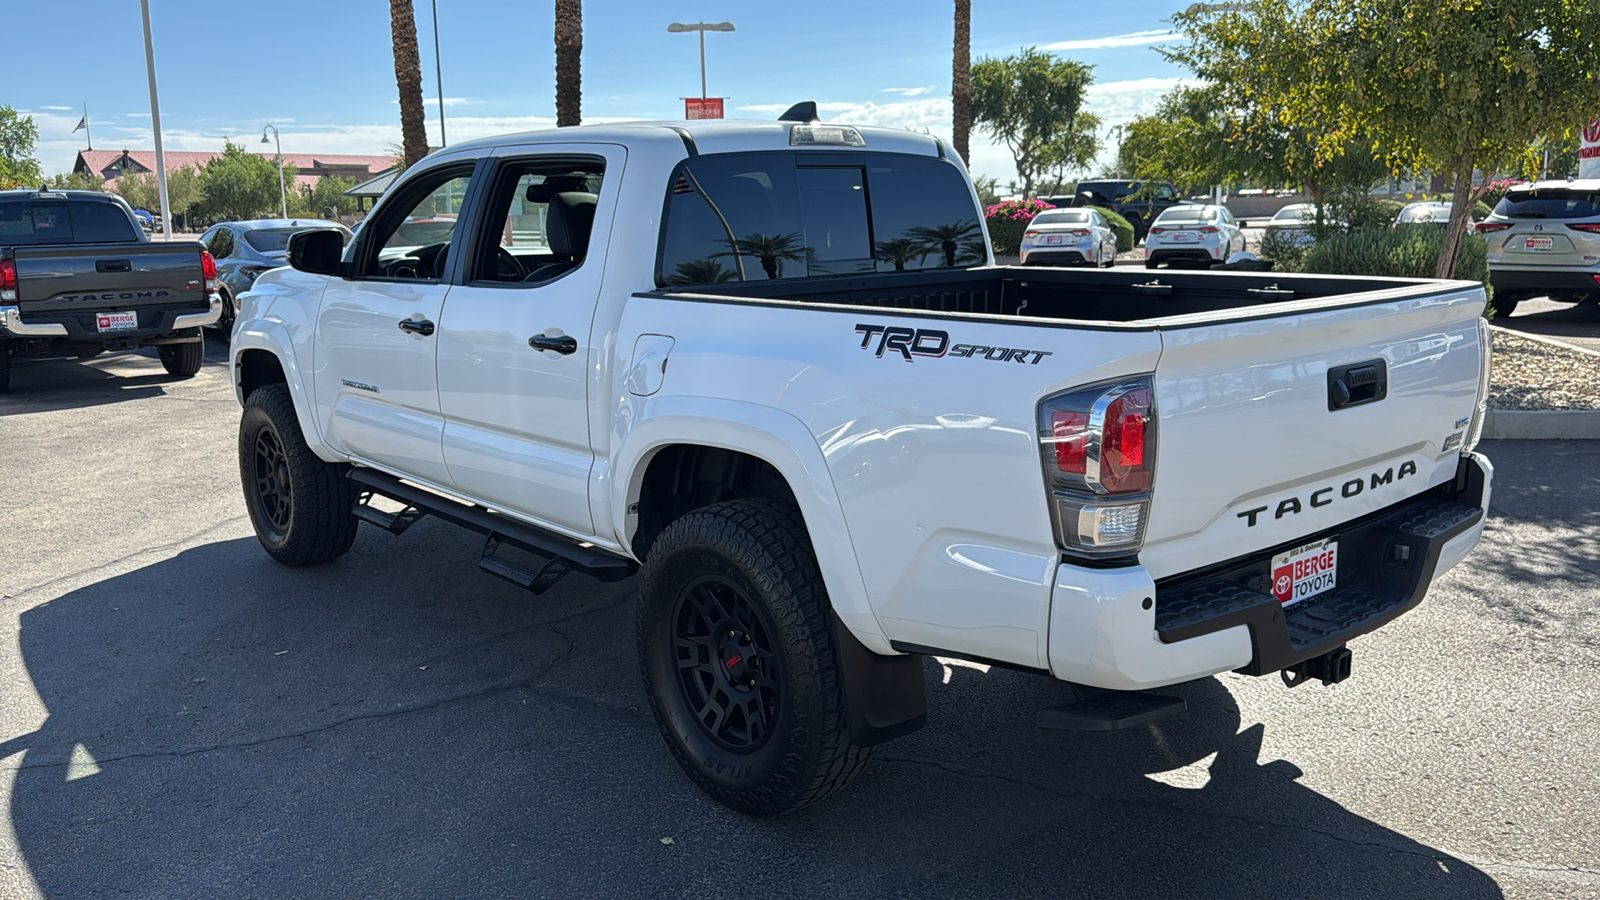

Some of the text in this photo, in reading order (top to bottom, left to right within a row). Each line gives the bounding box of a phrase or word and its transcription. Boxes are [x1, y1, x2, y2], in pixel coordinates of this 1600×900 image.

[62, 291, 169, 302] TACOMA
[111, 315, 134, 323] BERGE
[854, 323, 1054, 365] TRD SPORT
[1236, 459, 1417, 528] TACOMA
[1295, 550, 1334, 580] BERGE
[1294, 572, 1334, 598] TOYOTA
